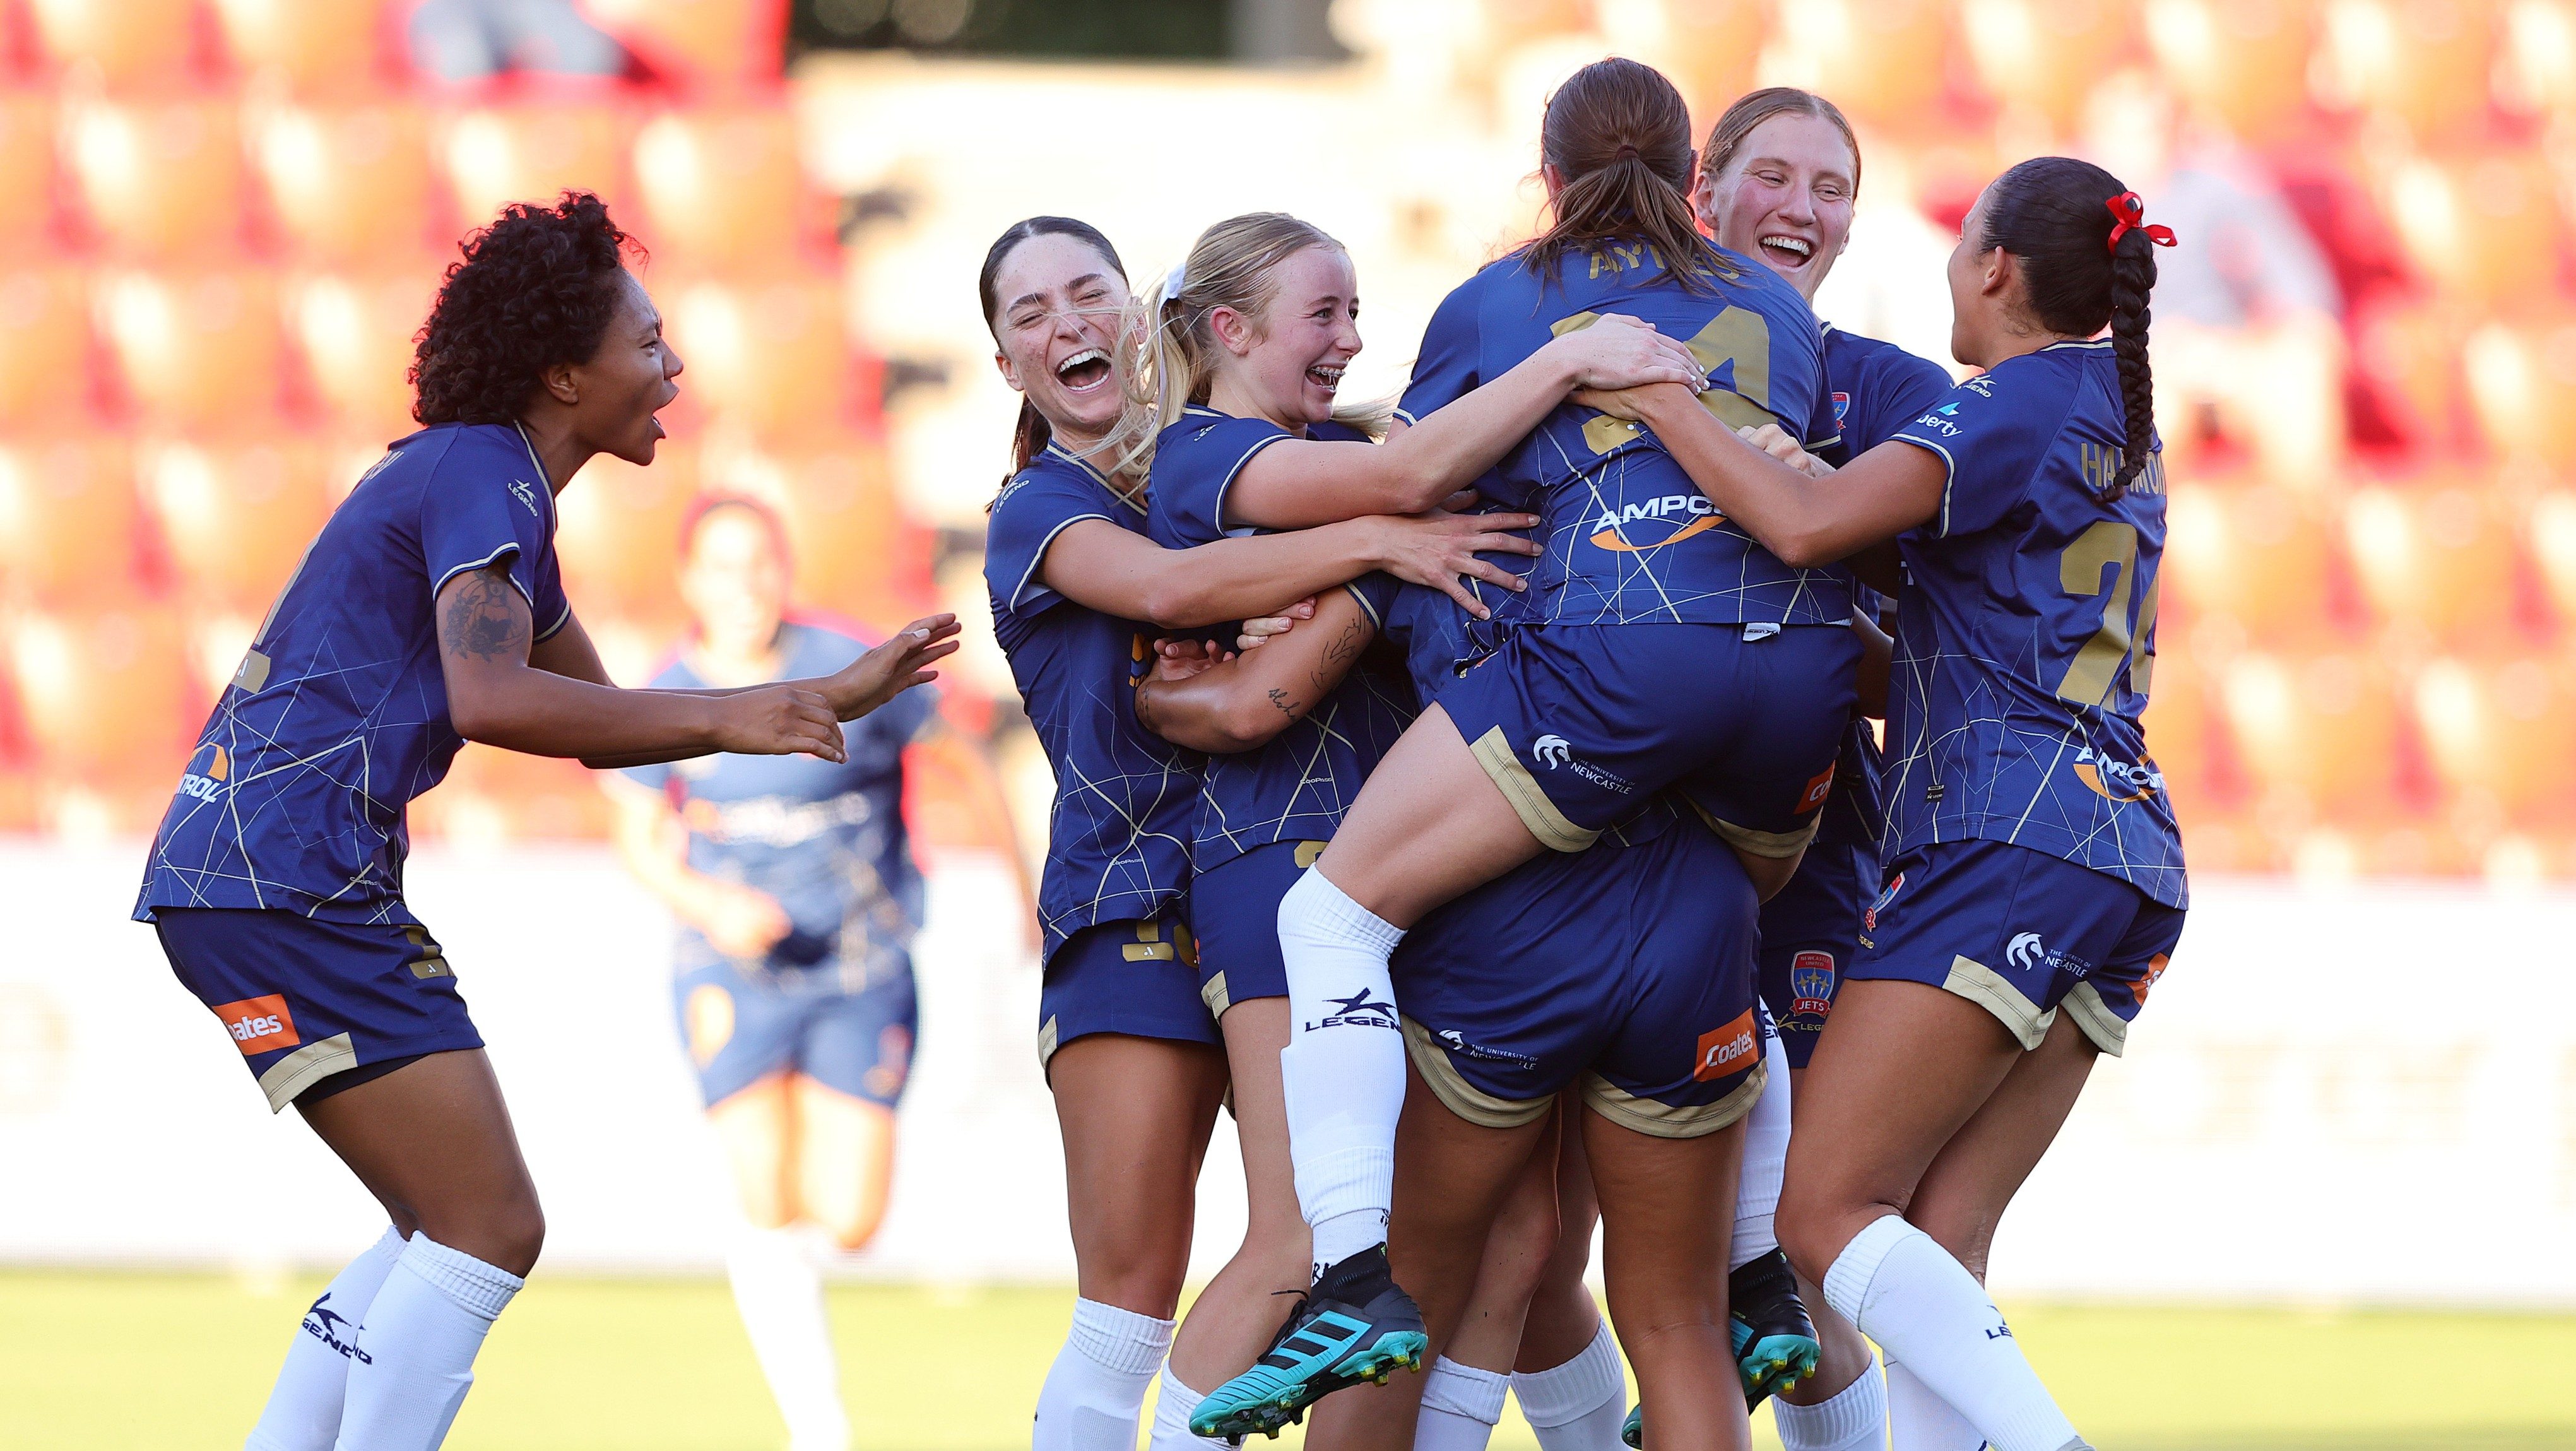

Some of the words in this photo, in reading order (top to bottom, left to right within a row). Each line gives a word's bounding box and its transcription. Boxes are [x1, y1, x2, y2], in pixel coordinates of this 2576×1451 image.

[1589, 244, 1740, 280] AYES
[508, 483, 538, 517] LEGEND
[996, 480, 1030, 514] LEGEND
[1570, 762, 1632, 795] NEWCASTLE
[1591, 764, 1626, 784] UNIVERSITY
[2050, 949, 2062, 957] THE
[2045, 956, 2087, 978] NEASTLE
[1799, 1001, 1824, 1012] JETS
[1305, 1017, 1402, 1033] LEGEN
[1487, 1048, 1527, 1060] UNIVERSITY
[1706, 1030, 1753, 1067] Coates
